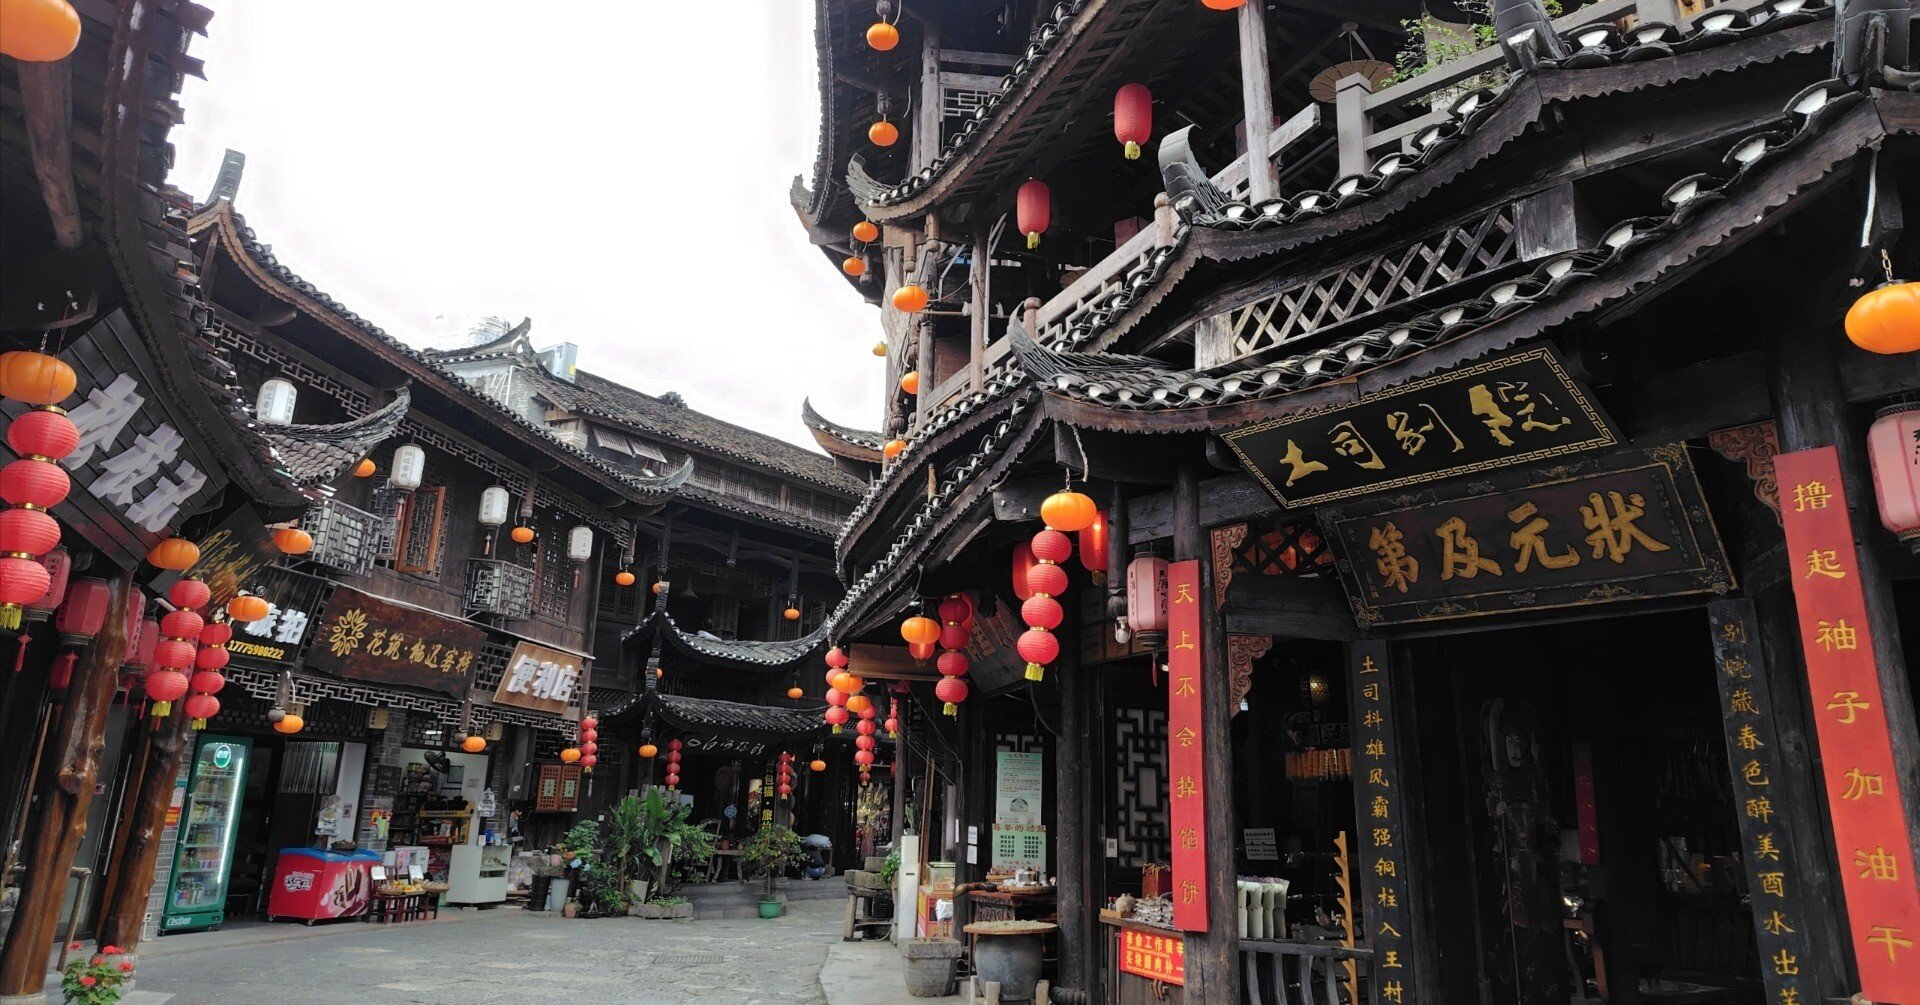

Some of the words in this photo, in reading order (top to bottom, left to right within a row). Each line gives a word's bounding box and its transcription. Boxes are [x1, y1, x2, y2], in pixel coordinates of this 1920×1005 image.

[506, 654, 578, 702] 便利店
[1173, 582, 1200, 904] 天上不会掉馅饼
[1792, 482, 1913, 962] 撸起袖子加油干
